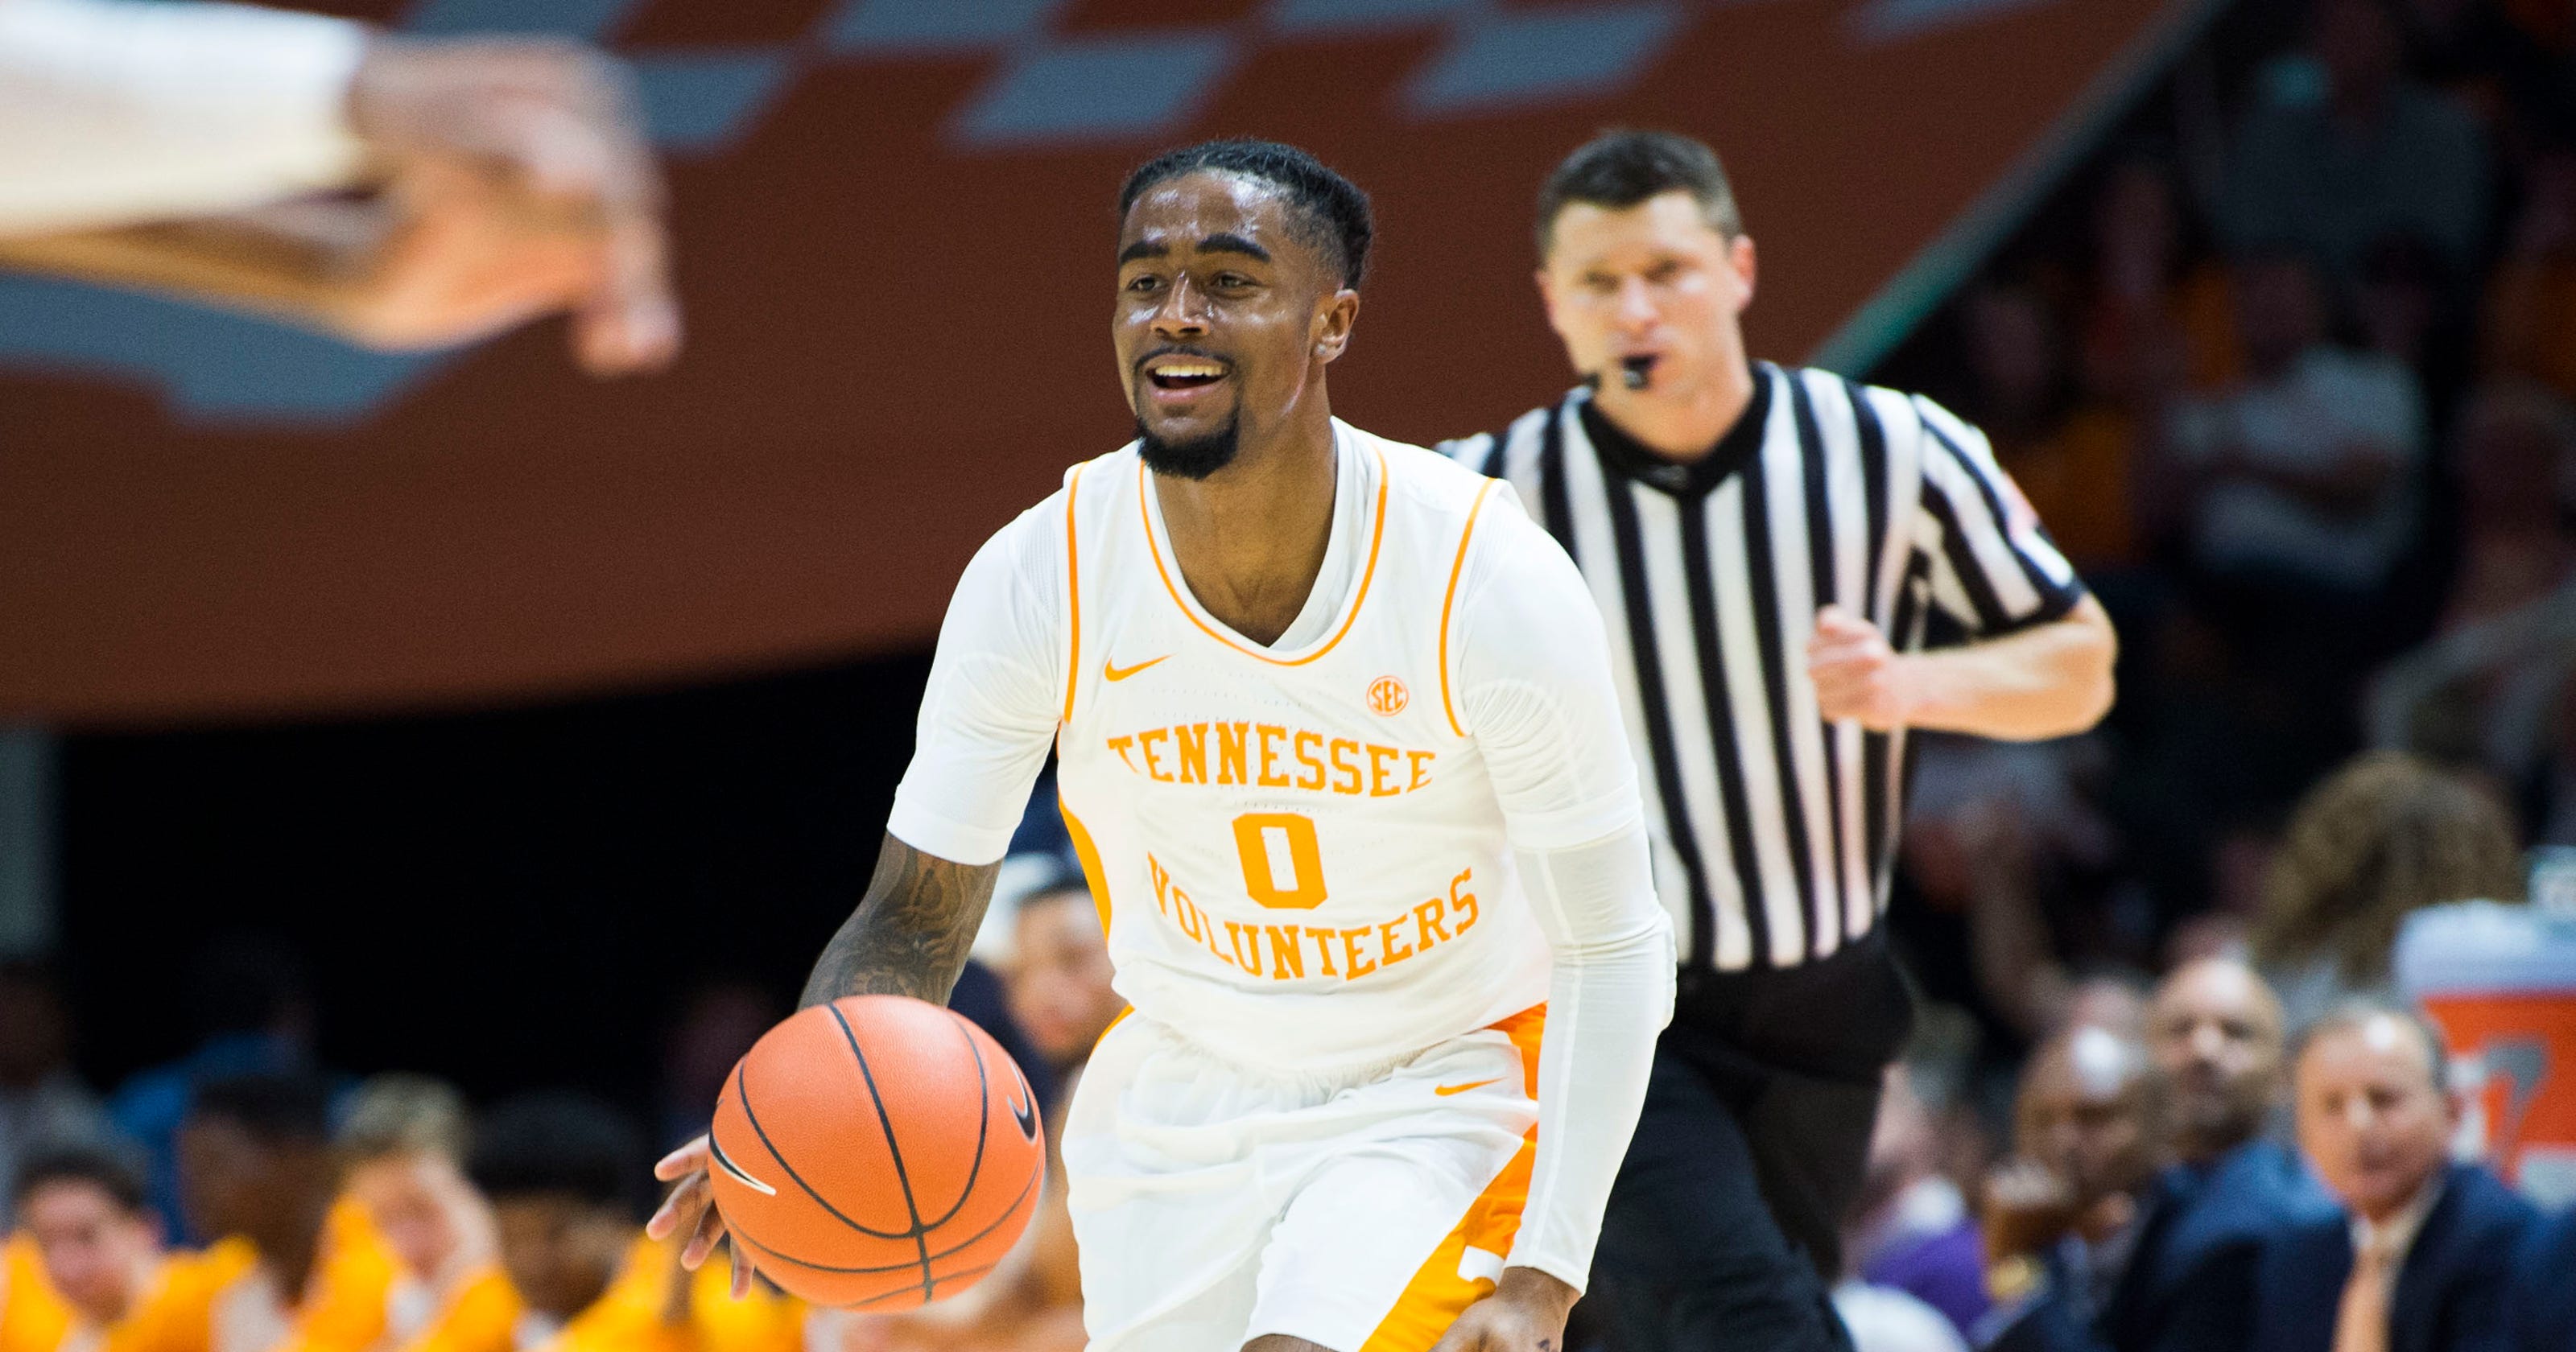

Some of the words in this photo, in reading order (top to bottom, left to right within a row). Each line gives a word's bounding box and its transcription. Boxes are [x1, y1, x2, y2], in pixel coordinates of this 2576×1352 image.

[1371, 681, 1404, 712] SEC
[1107, 722, 1436, 798] TENNESSEE
[1232, 813, 1328, 910] 0
[1147, 851, 1480, 981] VOLUNTEERS
